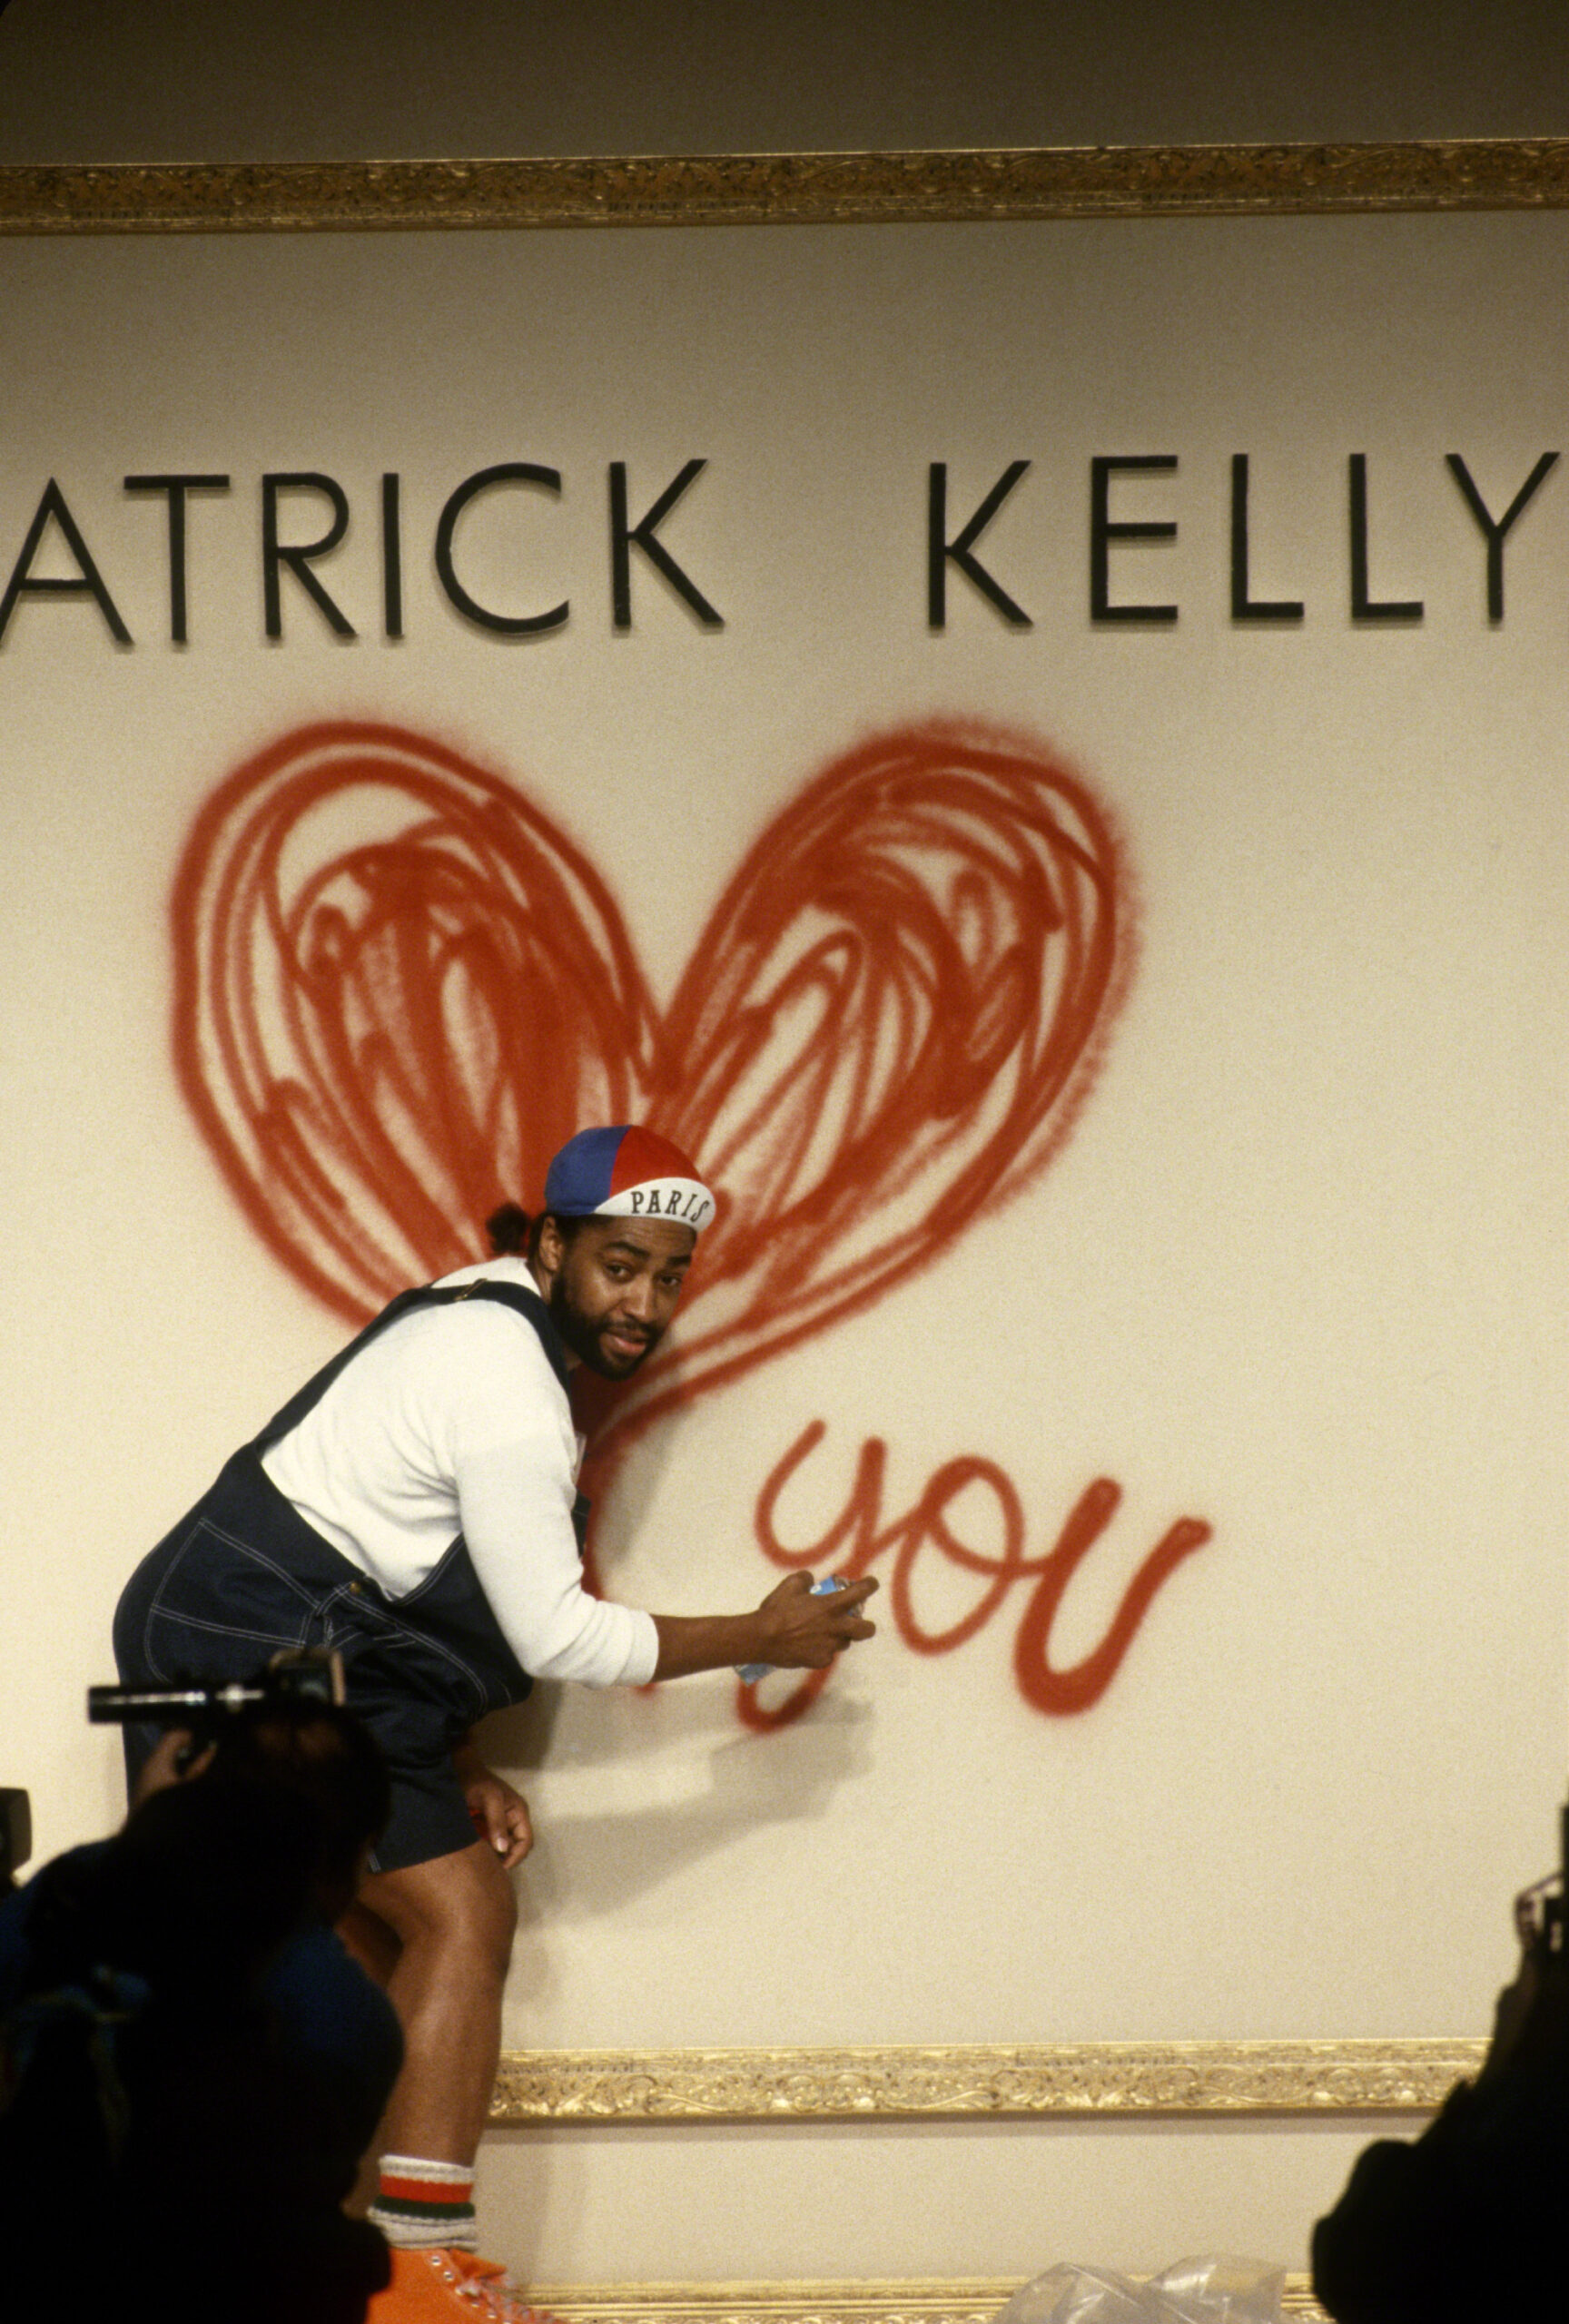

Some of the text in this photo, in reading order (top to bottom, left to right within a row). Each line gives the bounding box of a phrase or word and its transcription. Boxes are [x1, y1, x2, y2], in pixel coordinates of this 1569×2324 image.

[0, 451, 1562, 646] ATRICK KELLY
[630, 1189, 710, 1223] PARIS
